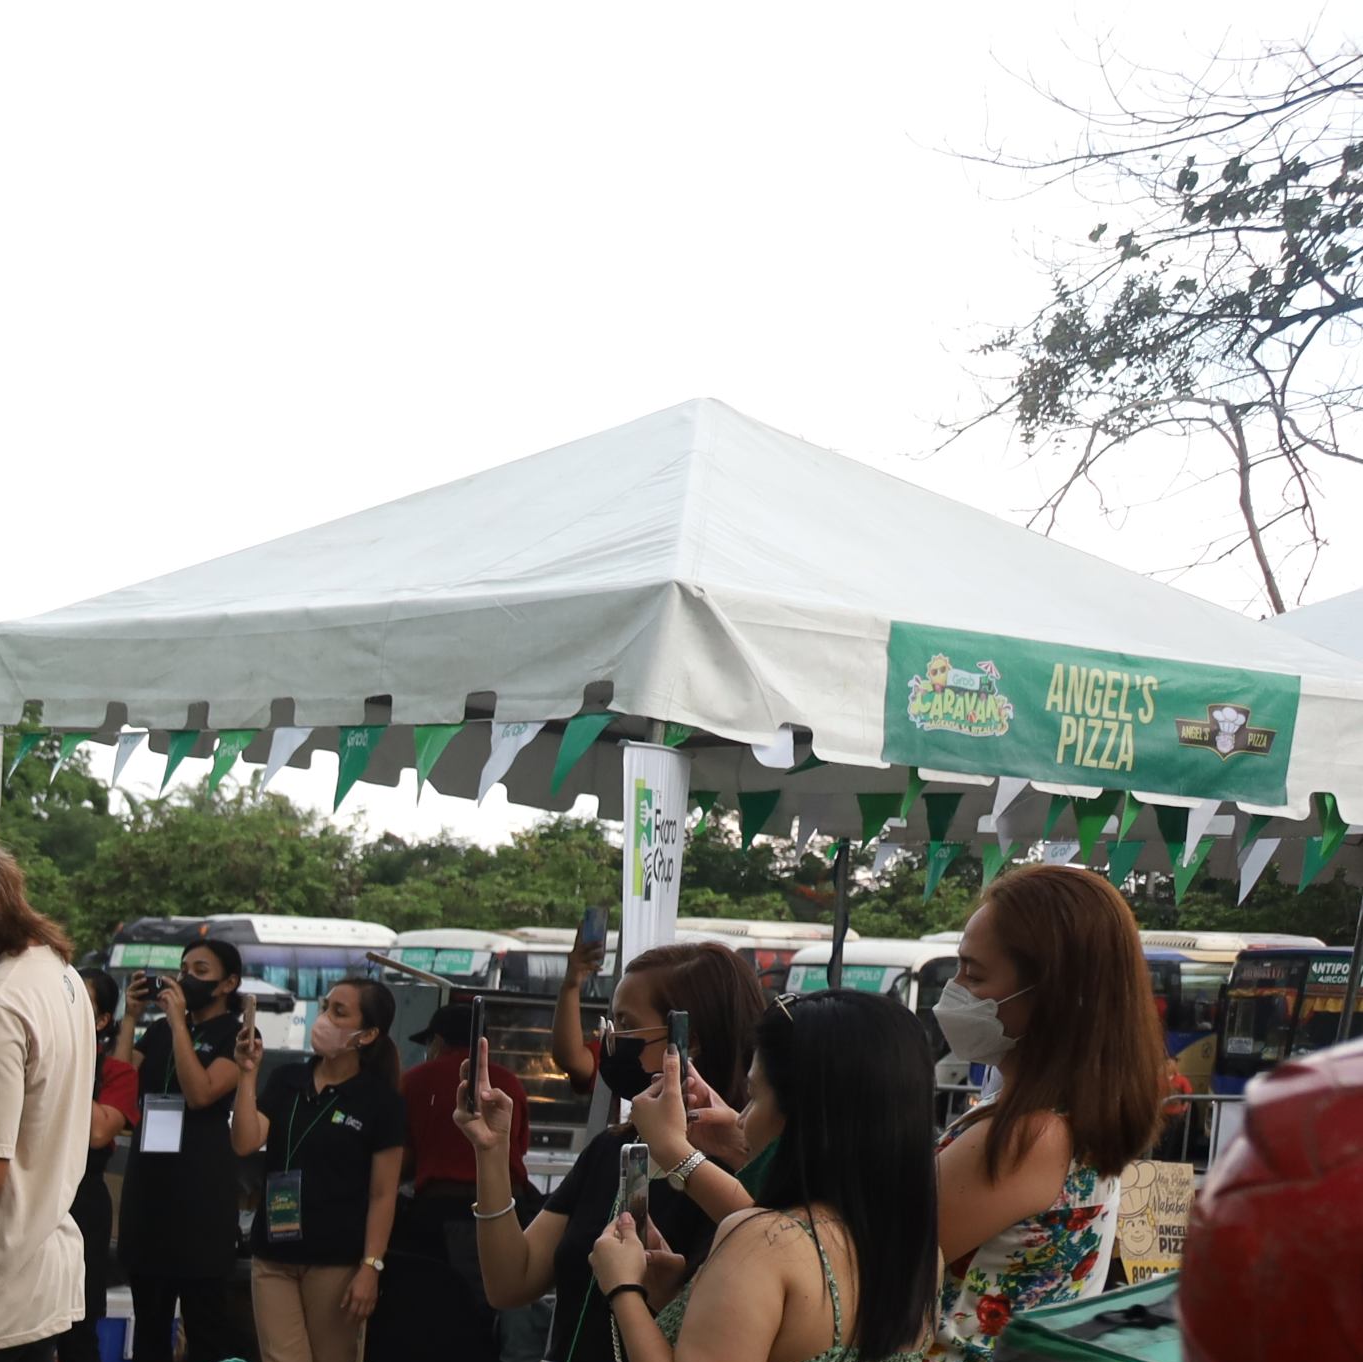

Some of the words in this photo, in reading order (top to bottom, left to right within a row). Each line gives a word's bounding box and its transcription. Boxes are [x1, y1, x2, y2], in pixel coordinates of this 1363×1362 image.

[915, 688, 1001, 723] CARAVAN
[1045, 662, 1159, 724] ANGEL'S
[1056, 716, 1135, 772] PIZZA
[1180, 725, 1210, 742] ANGEL'S
[1247, 732, 1268, 748] PIZZA
[1312, 962, 1350, 975] ANTIPO
[1159, 1225, 1187, 1237] ANGEL
